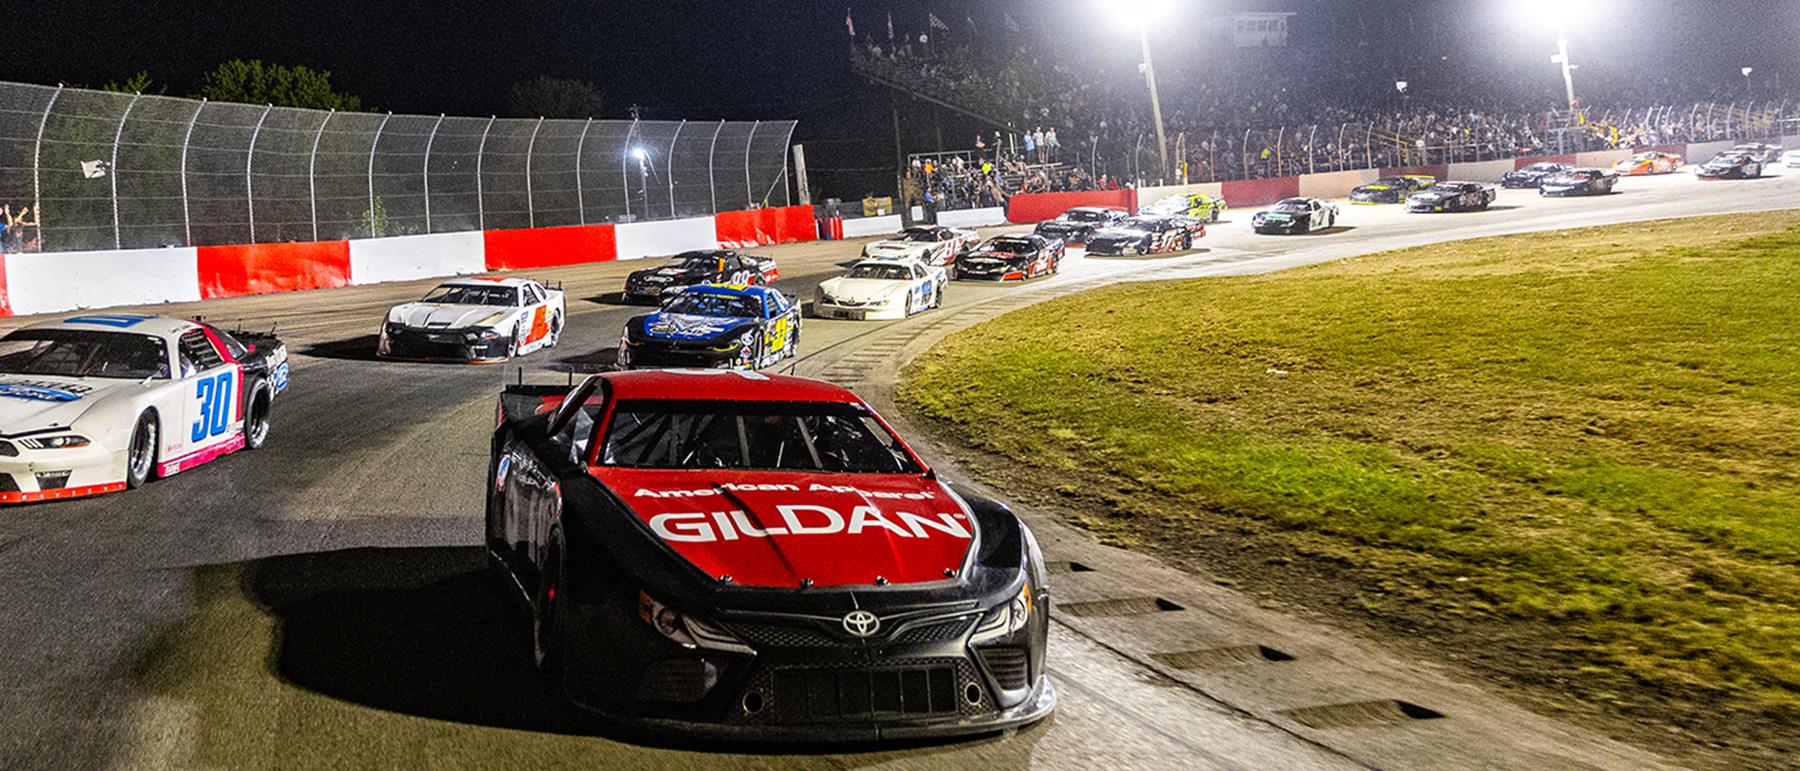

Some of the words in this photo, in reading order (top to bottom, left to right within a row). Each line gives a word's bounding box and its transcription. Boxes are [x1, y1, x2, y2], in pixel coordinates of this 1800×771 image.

[191, 371, 233, 444] 30
[634, 482, 800, 499] American
[809, 482, 935, 500] Apparel
[649, 504, 972, 543] GILDAN
